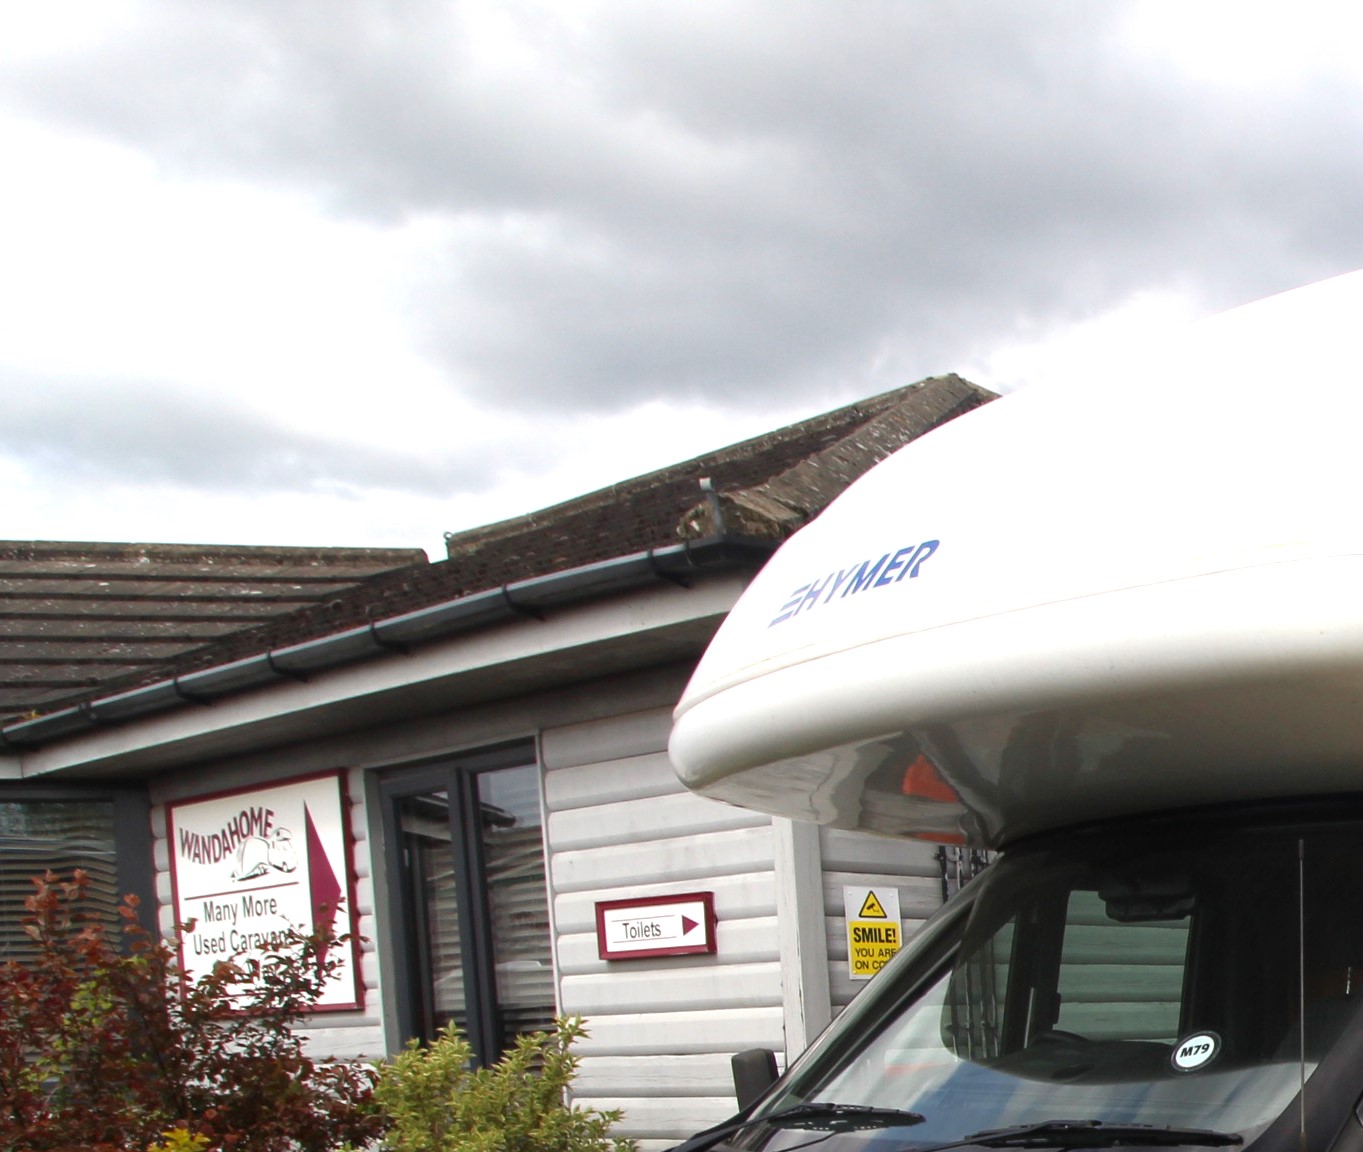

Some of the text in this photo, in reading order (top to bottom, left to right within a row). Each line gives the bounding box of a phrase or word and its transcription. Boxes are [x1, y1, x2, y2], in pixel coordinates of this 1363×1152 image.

[792, 539, 941, 618] HYMER
[179, 806, 274, 865] WANDAHOME
[203, 895, 277, 926] Many More
[622, 921, 662, 939] Toilets
[853, 927, 897, 944] SMILE!
[193, 929, 294, 956] Used Caravan
[855, 948, 897, 958] YOU ARE
[855, 960, 869, 970] ON
[1180, 1043, 1211, 1058] M79
